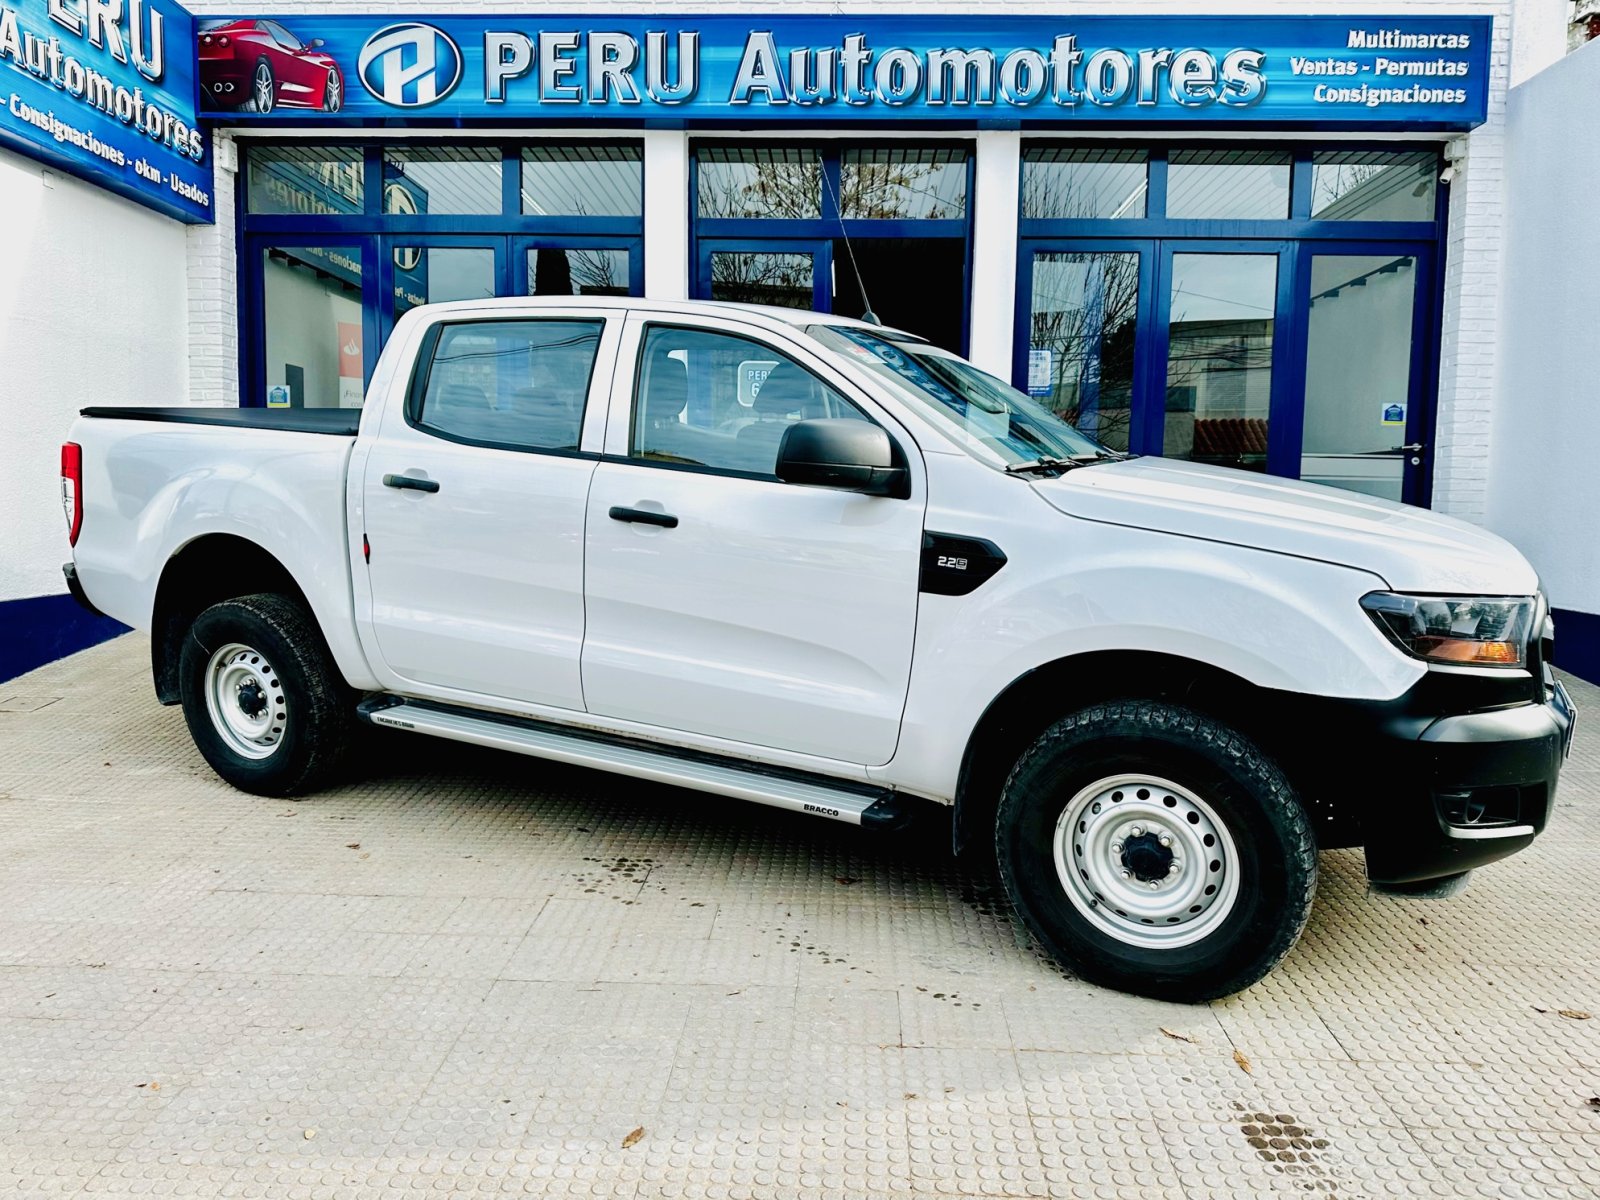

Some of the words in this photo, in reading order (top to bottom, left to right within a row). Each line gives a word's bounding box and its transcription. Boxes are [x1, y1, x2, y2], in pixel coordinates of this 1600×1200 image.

[1347, 29, 1470, 48] Multimarcas
[484, 30, 700, 104] PERU
[729, 29, 1267, 108] Automotores
[1290, 57, 1357, 75] Ventas
[1375, 57, 1469, 76] Permutas
[0, 7, 204, 163] Automotores
[1313, 83, 1466, 107] Consignaciones
[9, 93, 125, 166] Consignaciones
[171, 172, 209, 207] Usados
[748, 370, 771, 381] PER
[803, 803, 839, 817] BRACCO
